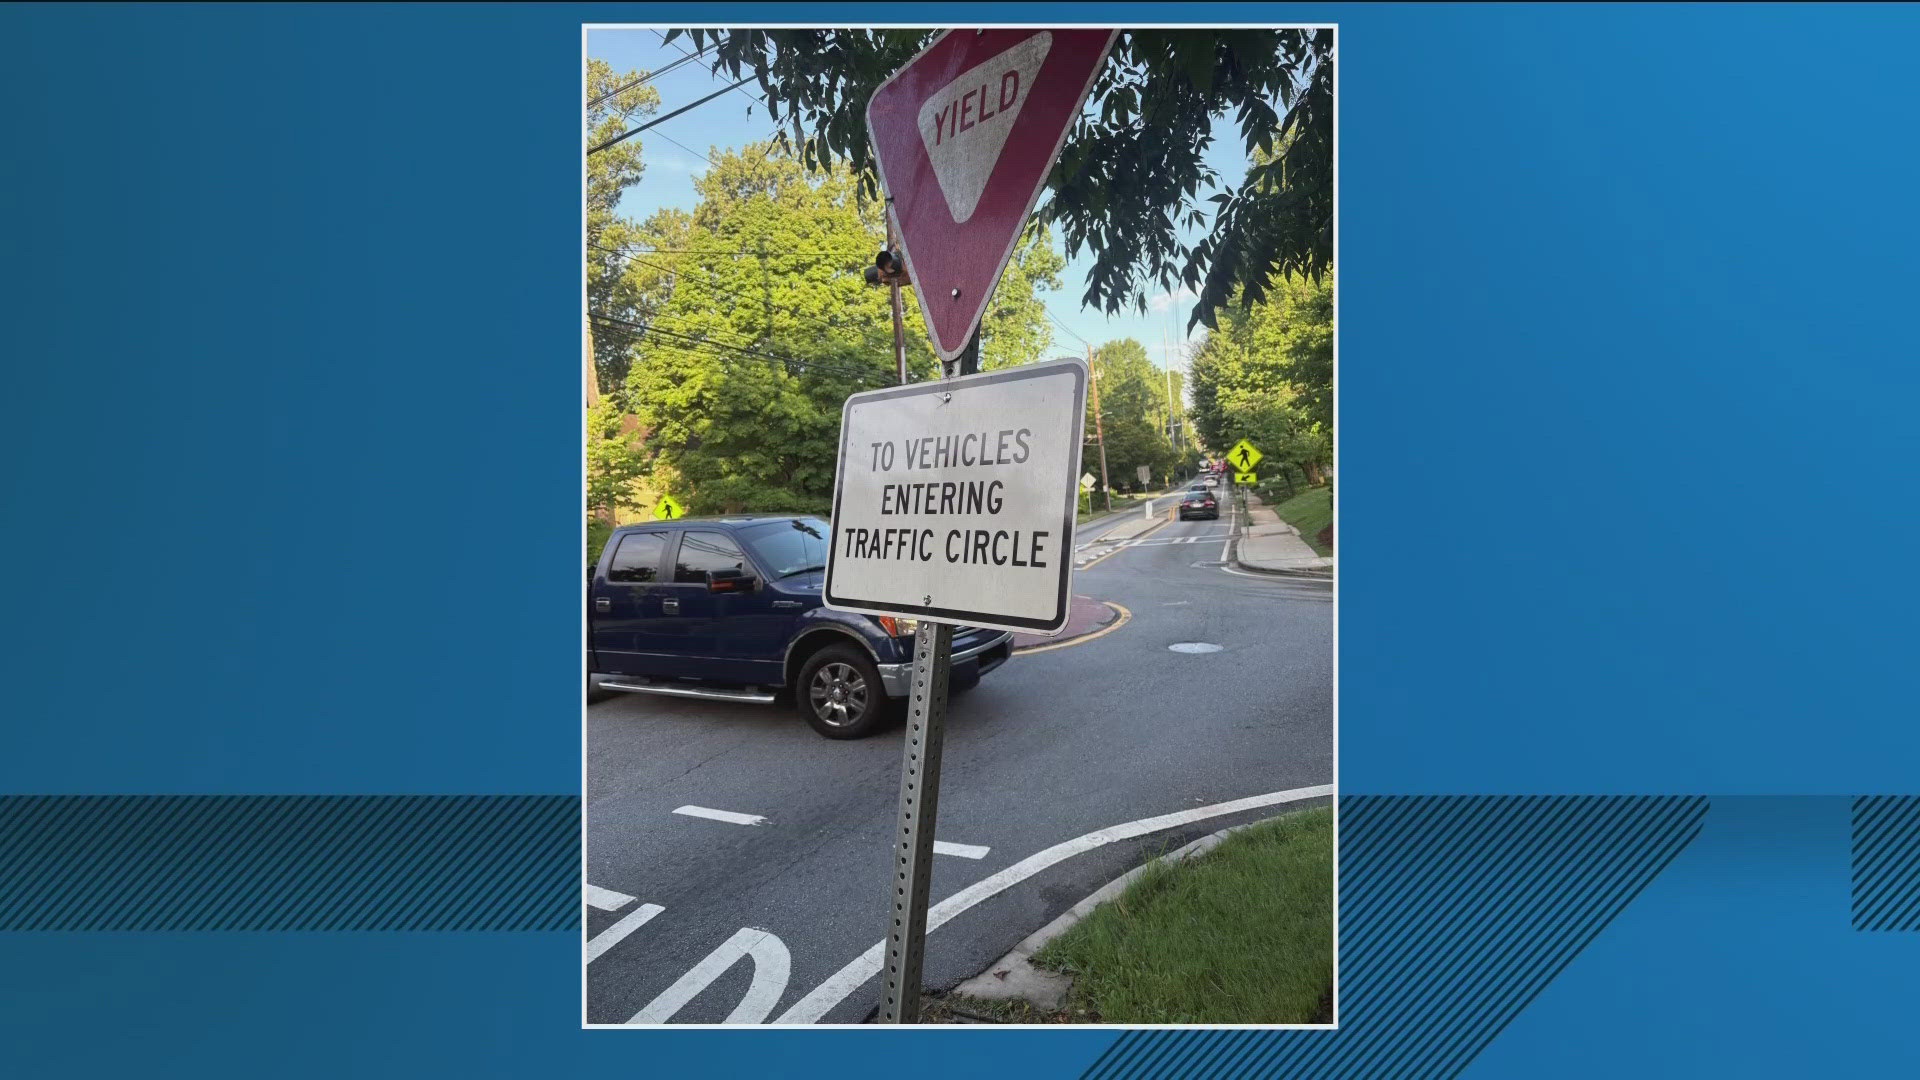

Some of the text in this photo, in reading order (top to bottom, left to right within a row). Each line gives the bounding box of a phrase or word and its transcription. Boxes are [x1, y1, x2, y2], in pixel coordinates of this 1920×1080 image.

[935, 70, 1019, 146] YIELD
[871, 428, 1031, 472] TO VEHICLES
[881, 480, 1003, 515] ENTERING
[845, 528, 1049, 568] TRAFFIC CIRCLE
